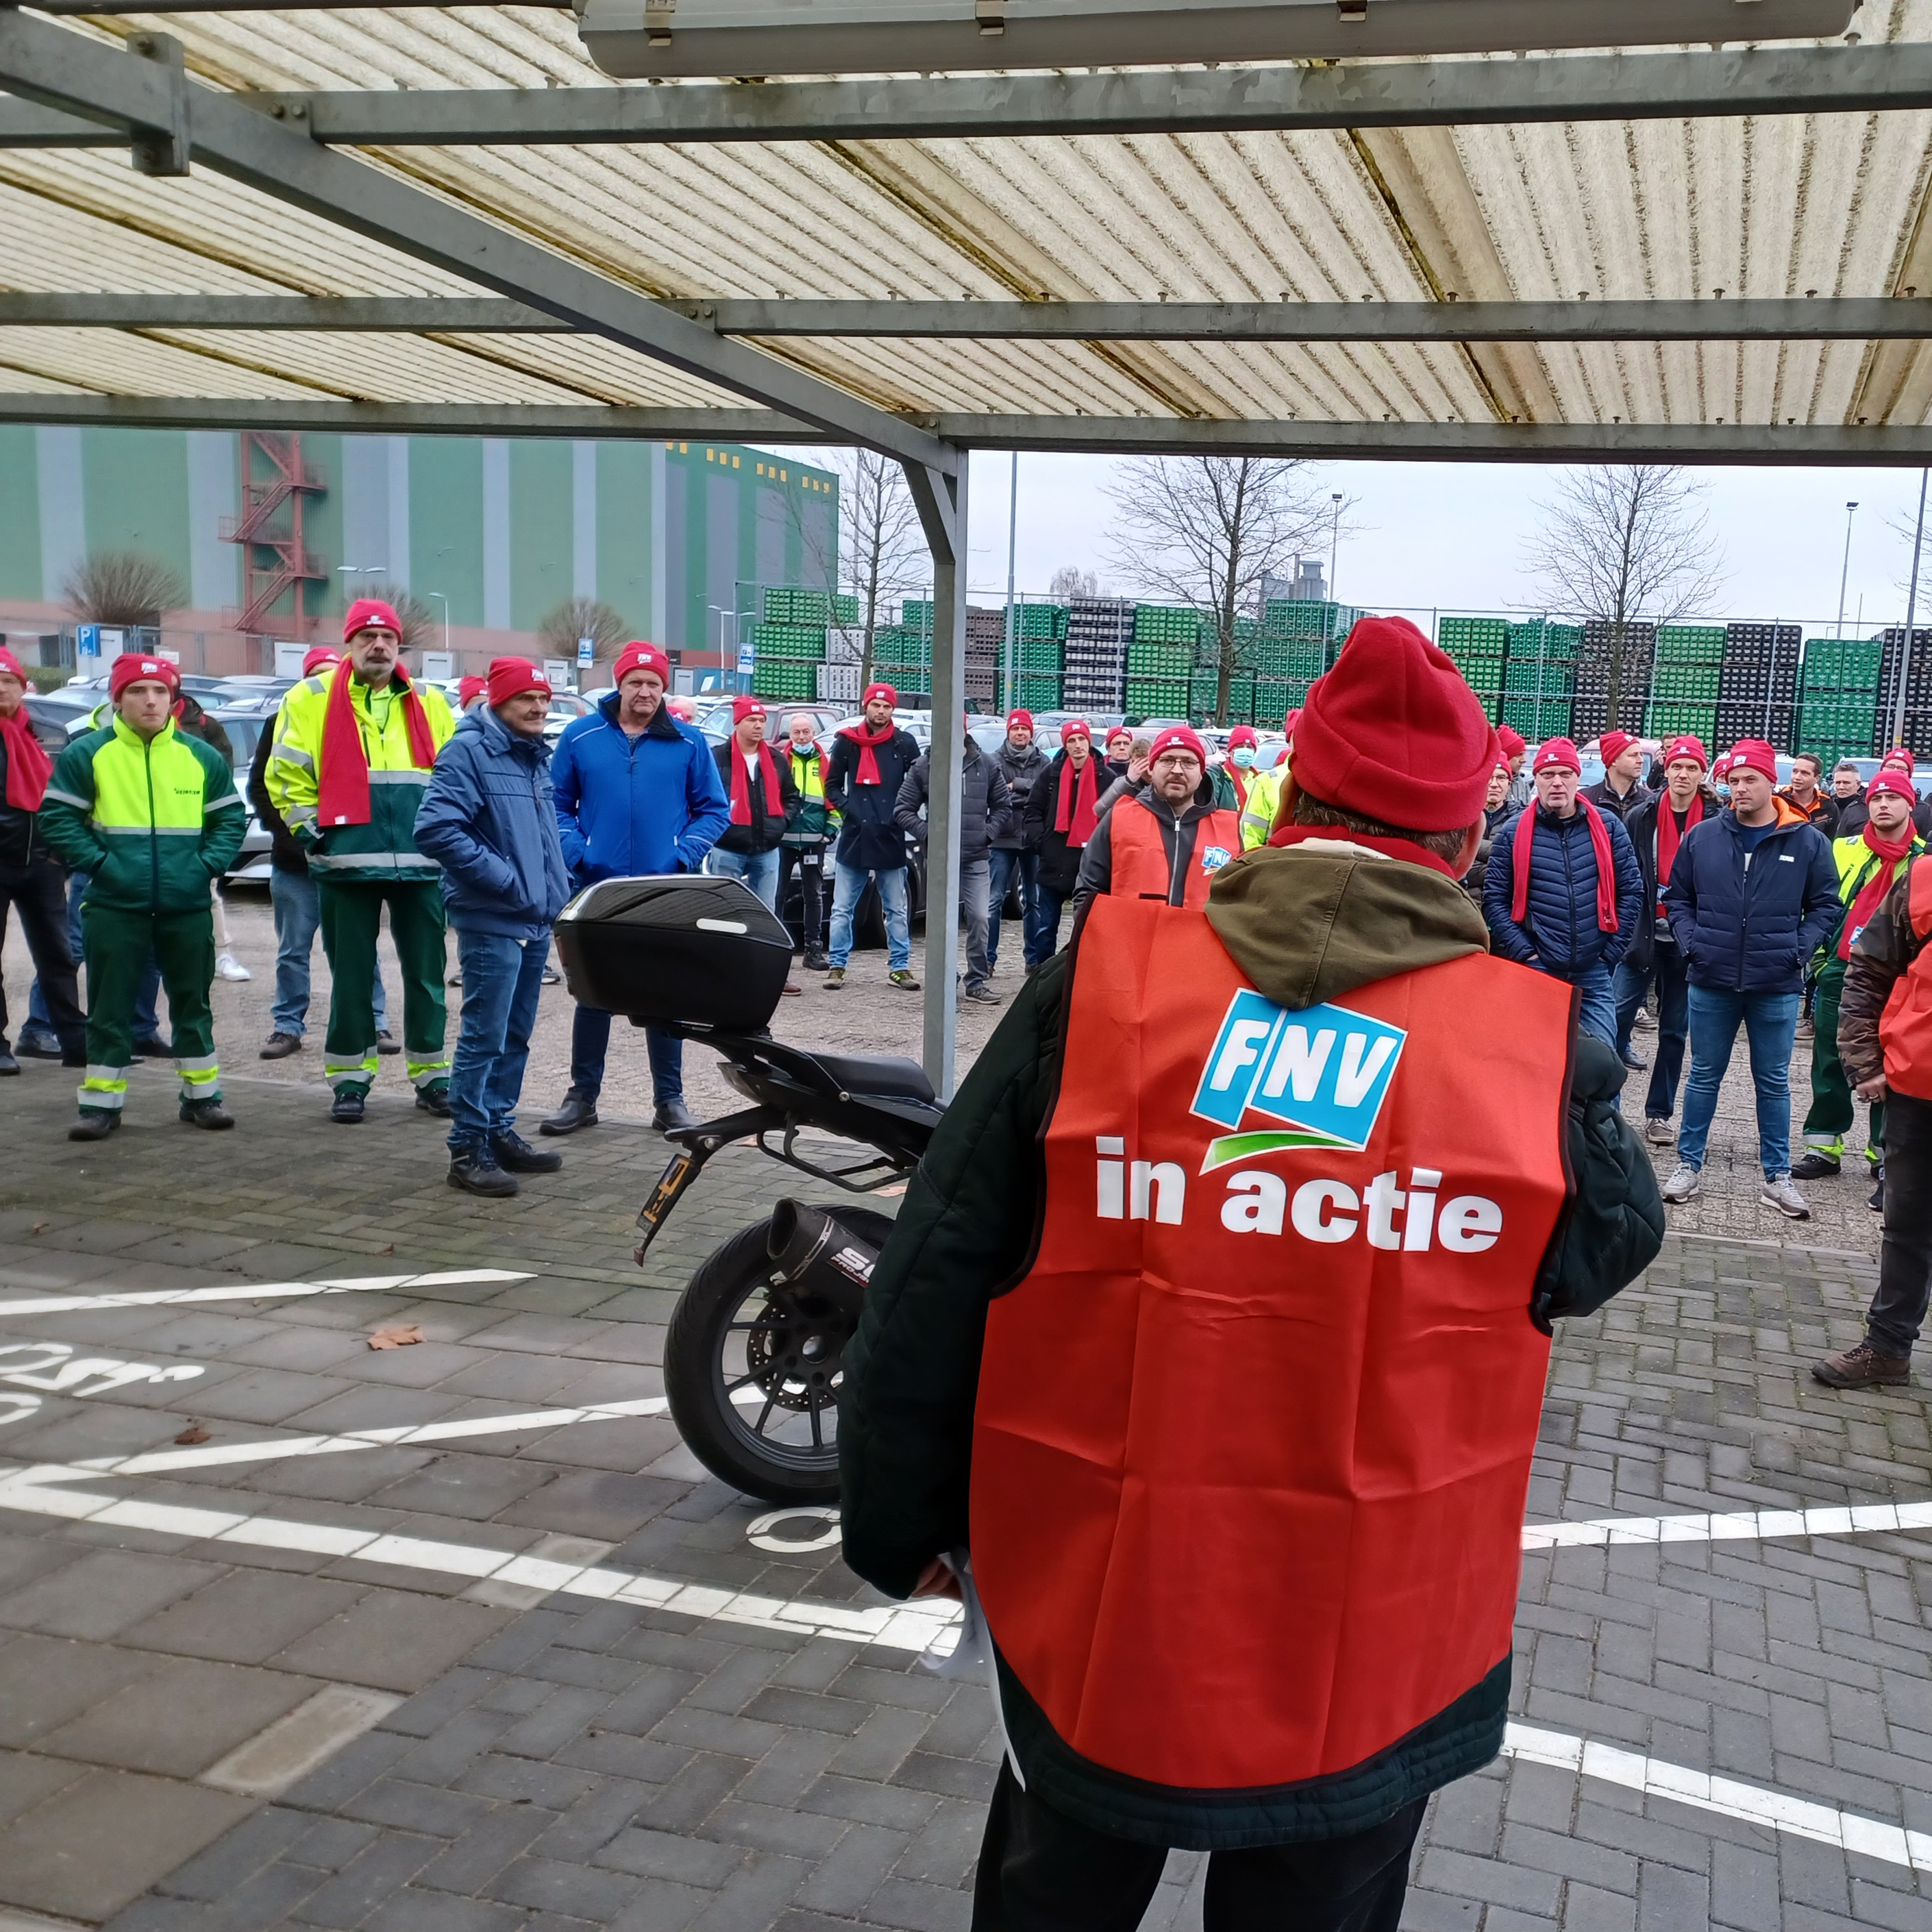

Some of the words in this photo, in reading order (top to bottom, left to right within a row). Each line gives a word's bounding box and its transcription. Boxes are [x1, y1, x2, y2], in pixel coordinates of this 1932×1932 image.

[81, 628, 91, 643] P
[1204, 850, 1230, 867] FNV
[1209, 1019, 1398, 1108] FNV
[1096, 1136, 1186, 1225] in
[1221, 1167, 1503, 1252] actie
[830, 1256, 869, 1283] PROJE
